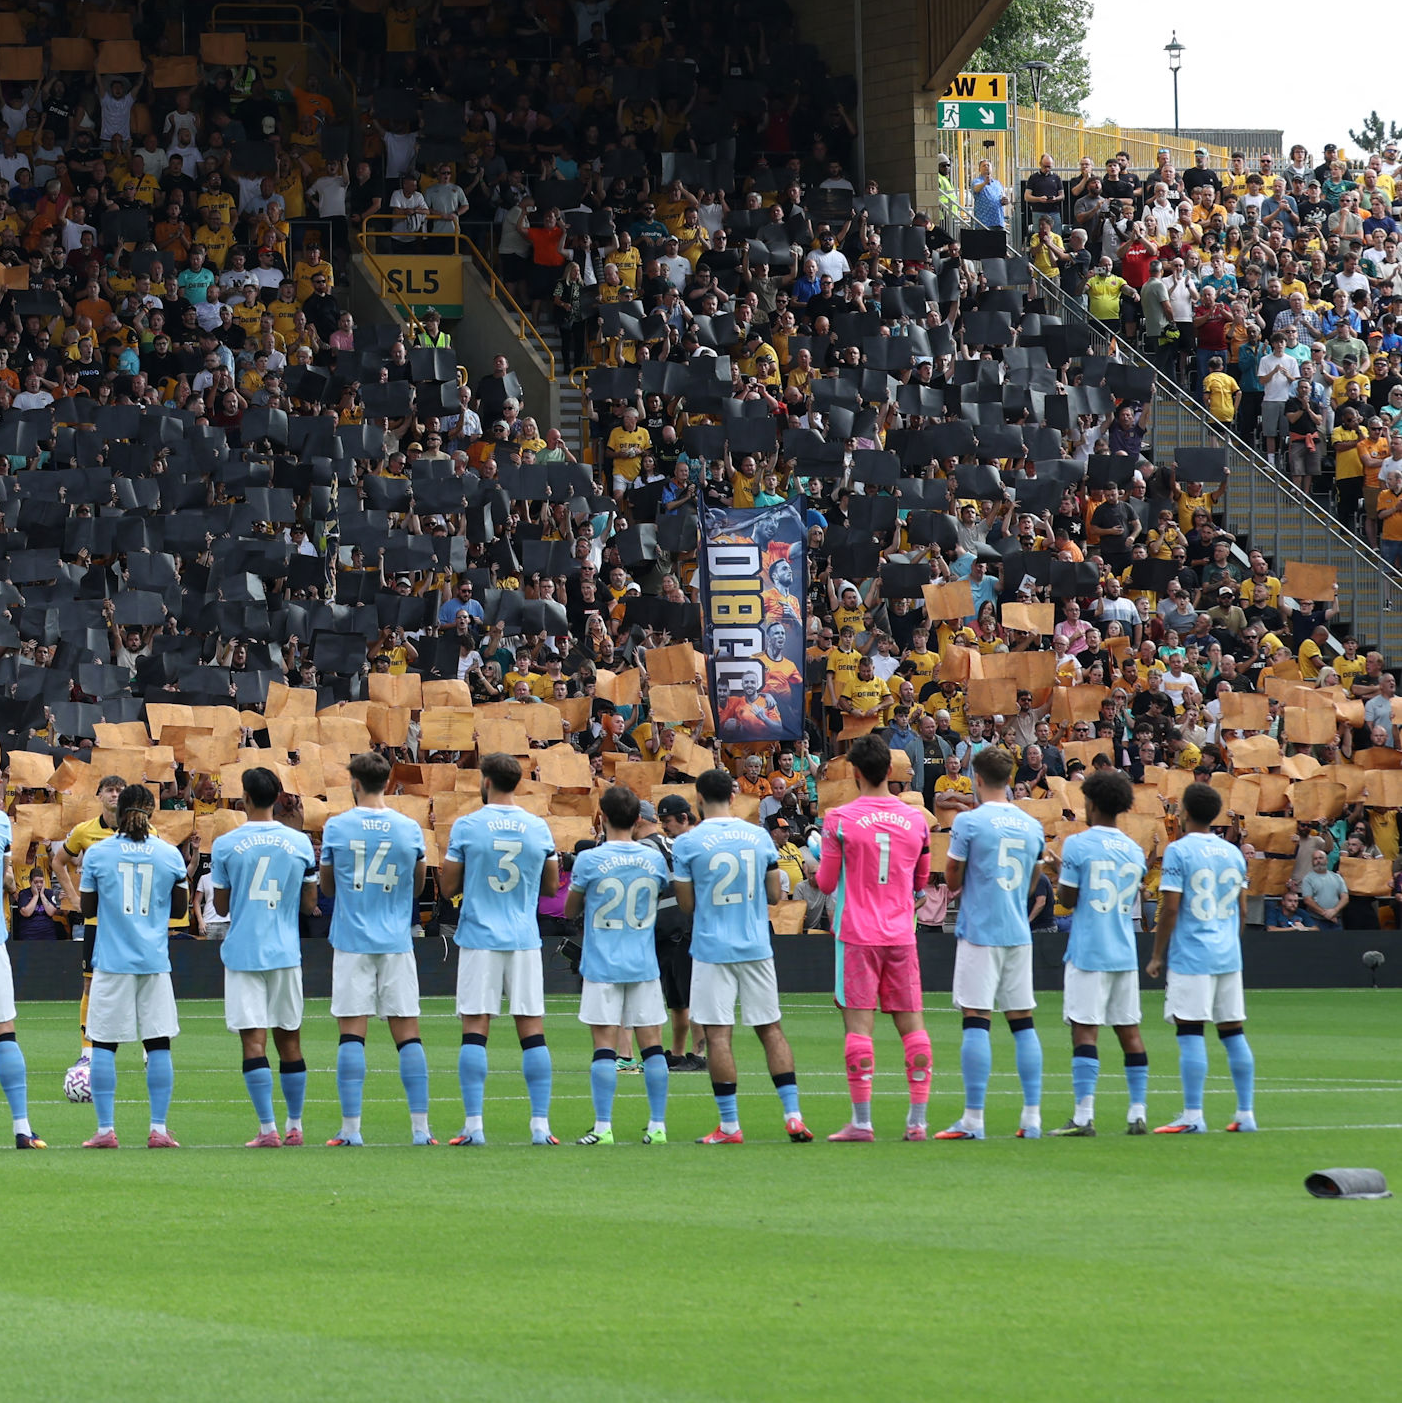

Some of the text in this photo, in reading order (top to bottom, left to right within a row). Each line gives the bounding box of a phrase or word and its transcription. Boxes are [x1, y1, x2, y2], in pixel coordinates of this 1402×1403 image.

[988, 78, 998, 97] 1
[387, 269, 439, 294] SL5
[857, 691, 879, 699] DEBET
[120, 841, 155, 855] DOKU
[362, 819, 391, 833] NICO
[856, 813, 911, 831] TRAFFORD
[990, 814, 1030, 832] STONES
[249, 856, 282, 910] 4
[349, 840, 399, 893] 14
[487, 840, 522, 893] 3
[597, 854, 657, 876] BERNARDO
[709, 848, 755, 906] 21
[875, 832, 891, 884] 1
[997, 838, 1025, 892] 5
[118, 862, 153, 916] 11
[592, 877, 658, 930] 20
[1089, 860, 1143, 914] 52
[1191, 868, 1243, 921] 82
